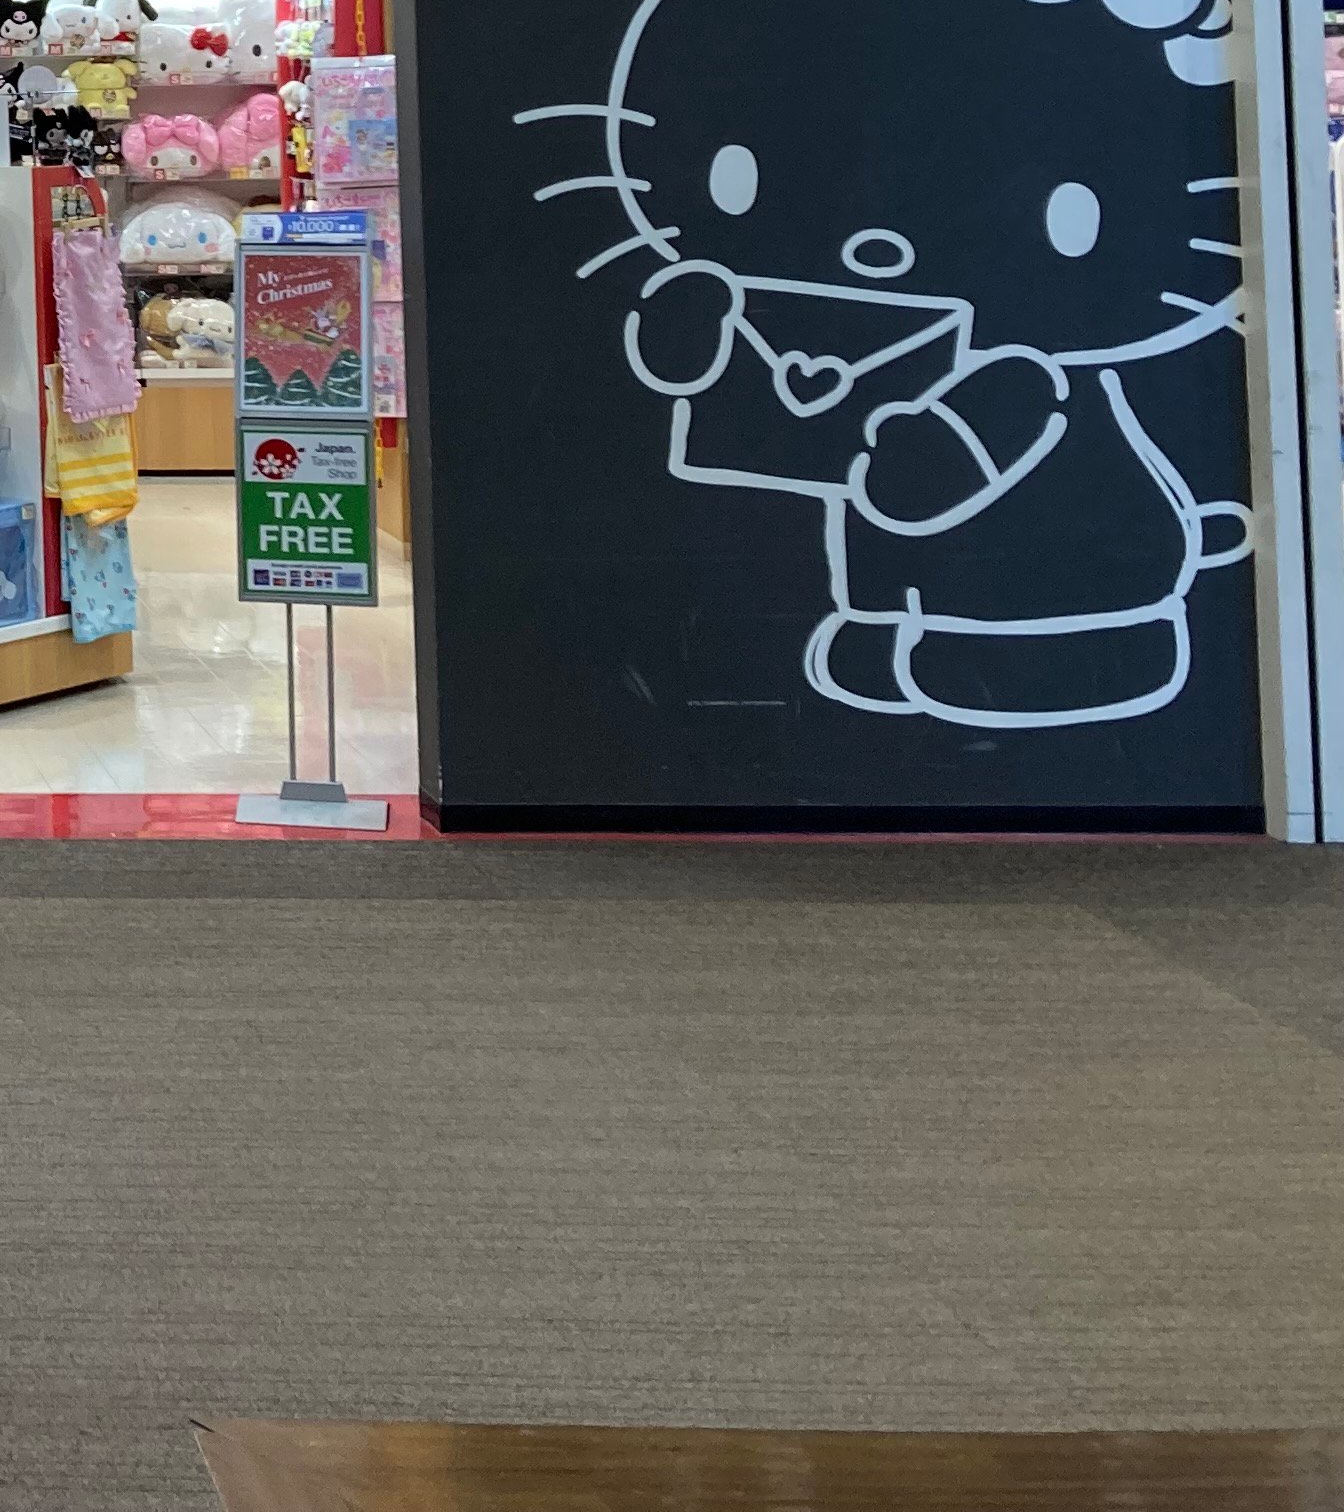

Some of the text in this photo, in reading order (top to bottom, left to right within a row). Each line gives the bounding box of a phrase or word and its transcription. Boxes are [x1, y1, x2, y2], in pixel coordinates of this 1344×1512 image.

[50, 46, 61, 55] M
[155, 169, 163, 179] S
[257, 271, 280, 287] My
[257, 279, 333, 304] Christmas
[311, 455, 357, 468] Tax-free
[328, 468, 357, 480] Shop
[266, 491, 344, 520] TAX
[259, 524, 354, 555] FREE
